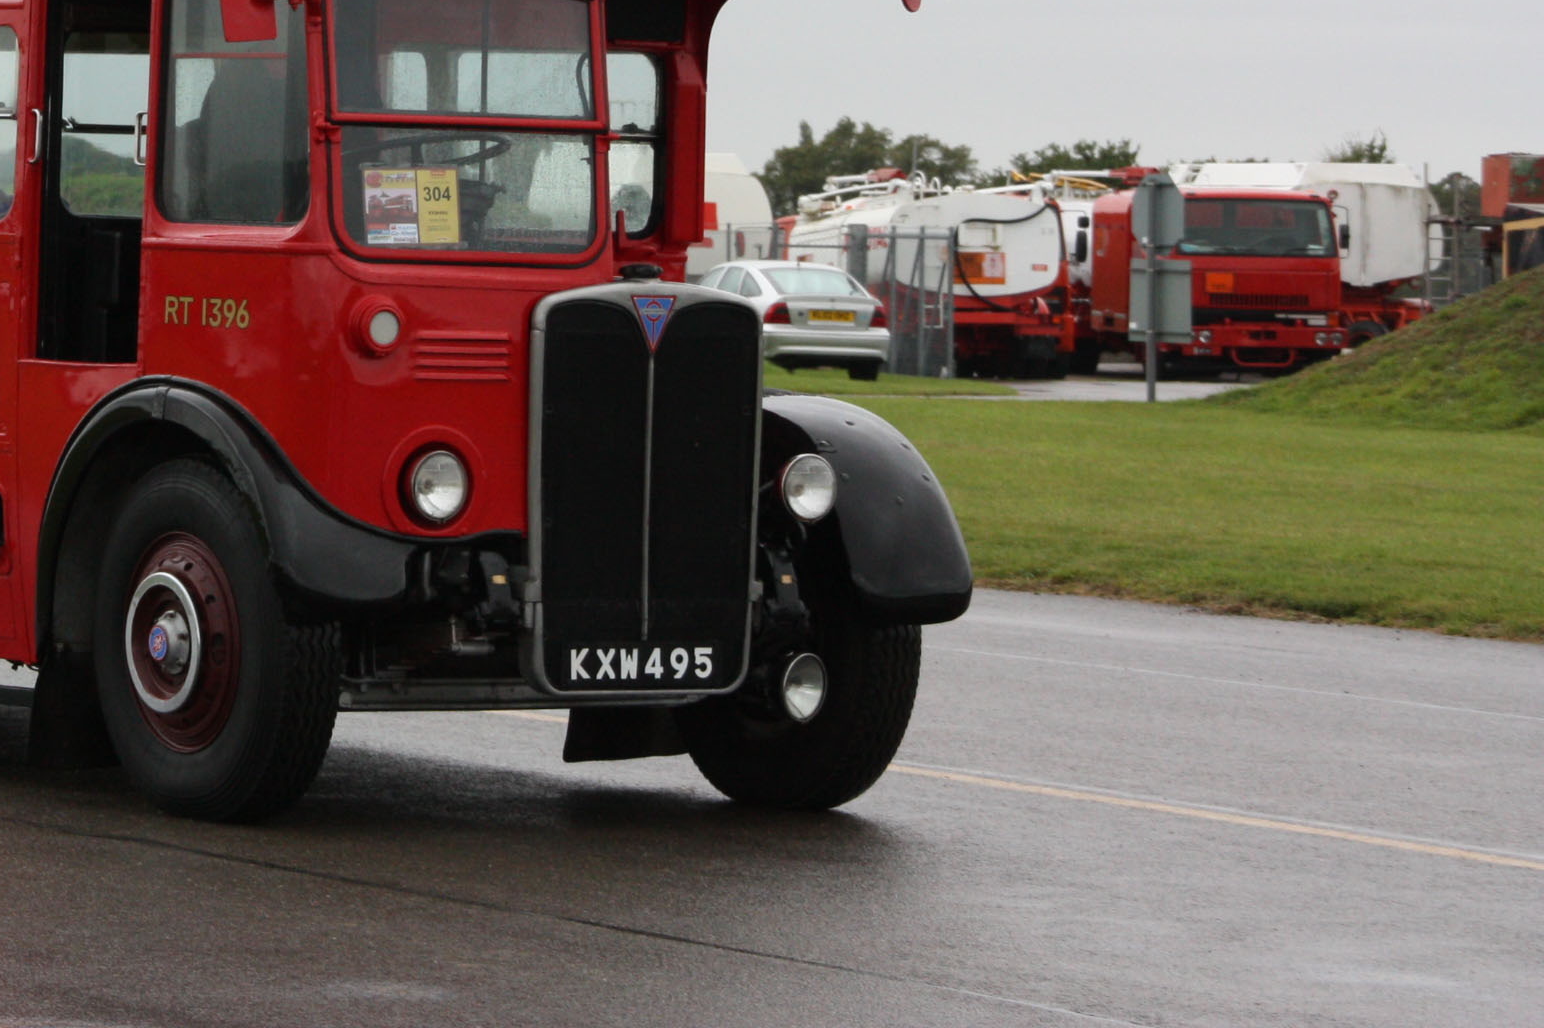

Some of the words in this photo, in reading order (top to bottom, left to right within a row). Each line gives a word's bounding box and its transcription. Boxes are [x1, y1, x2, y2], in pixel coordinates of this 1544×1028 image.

[423, 186, 452, 202] 304
[164, 295, 194, 324] RT
[201, 298, 250, 329] 1396
[570, 647, 713, 680] KXW495
